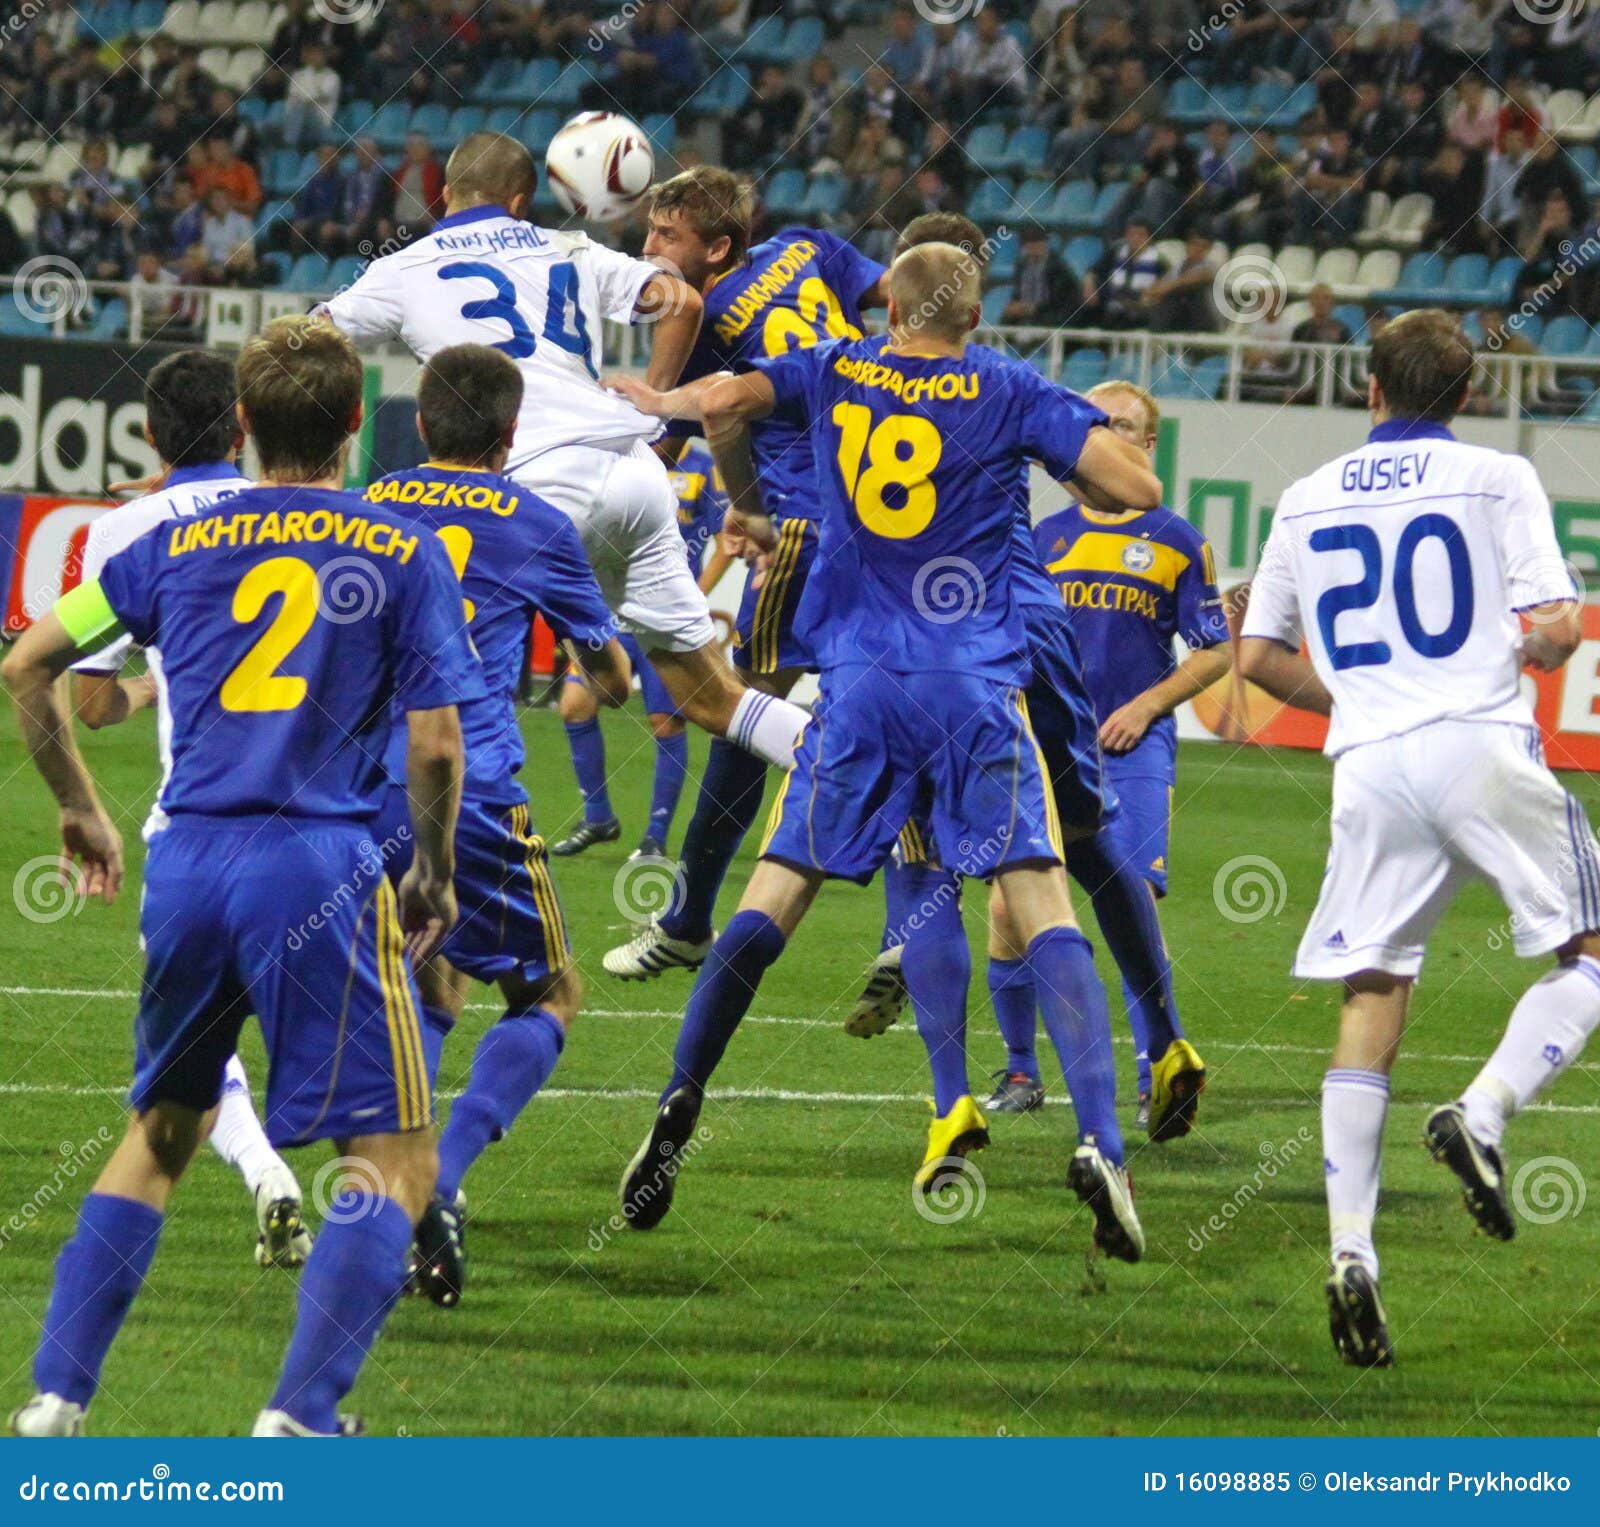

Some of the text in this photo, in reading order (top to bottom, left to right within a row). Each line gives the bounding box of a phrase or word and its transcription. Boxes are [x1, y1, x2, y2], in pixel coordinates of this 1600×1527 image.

[437, 261, 599, 380] 34
[832, 400, 943, 540] 18
[1342, 452, 1431, 492] GUSIEV
[220, 556, 320, 712] 2
[1309, 513, 1475, 671] 20
